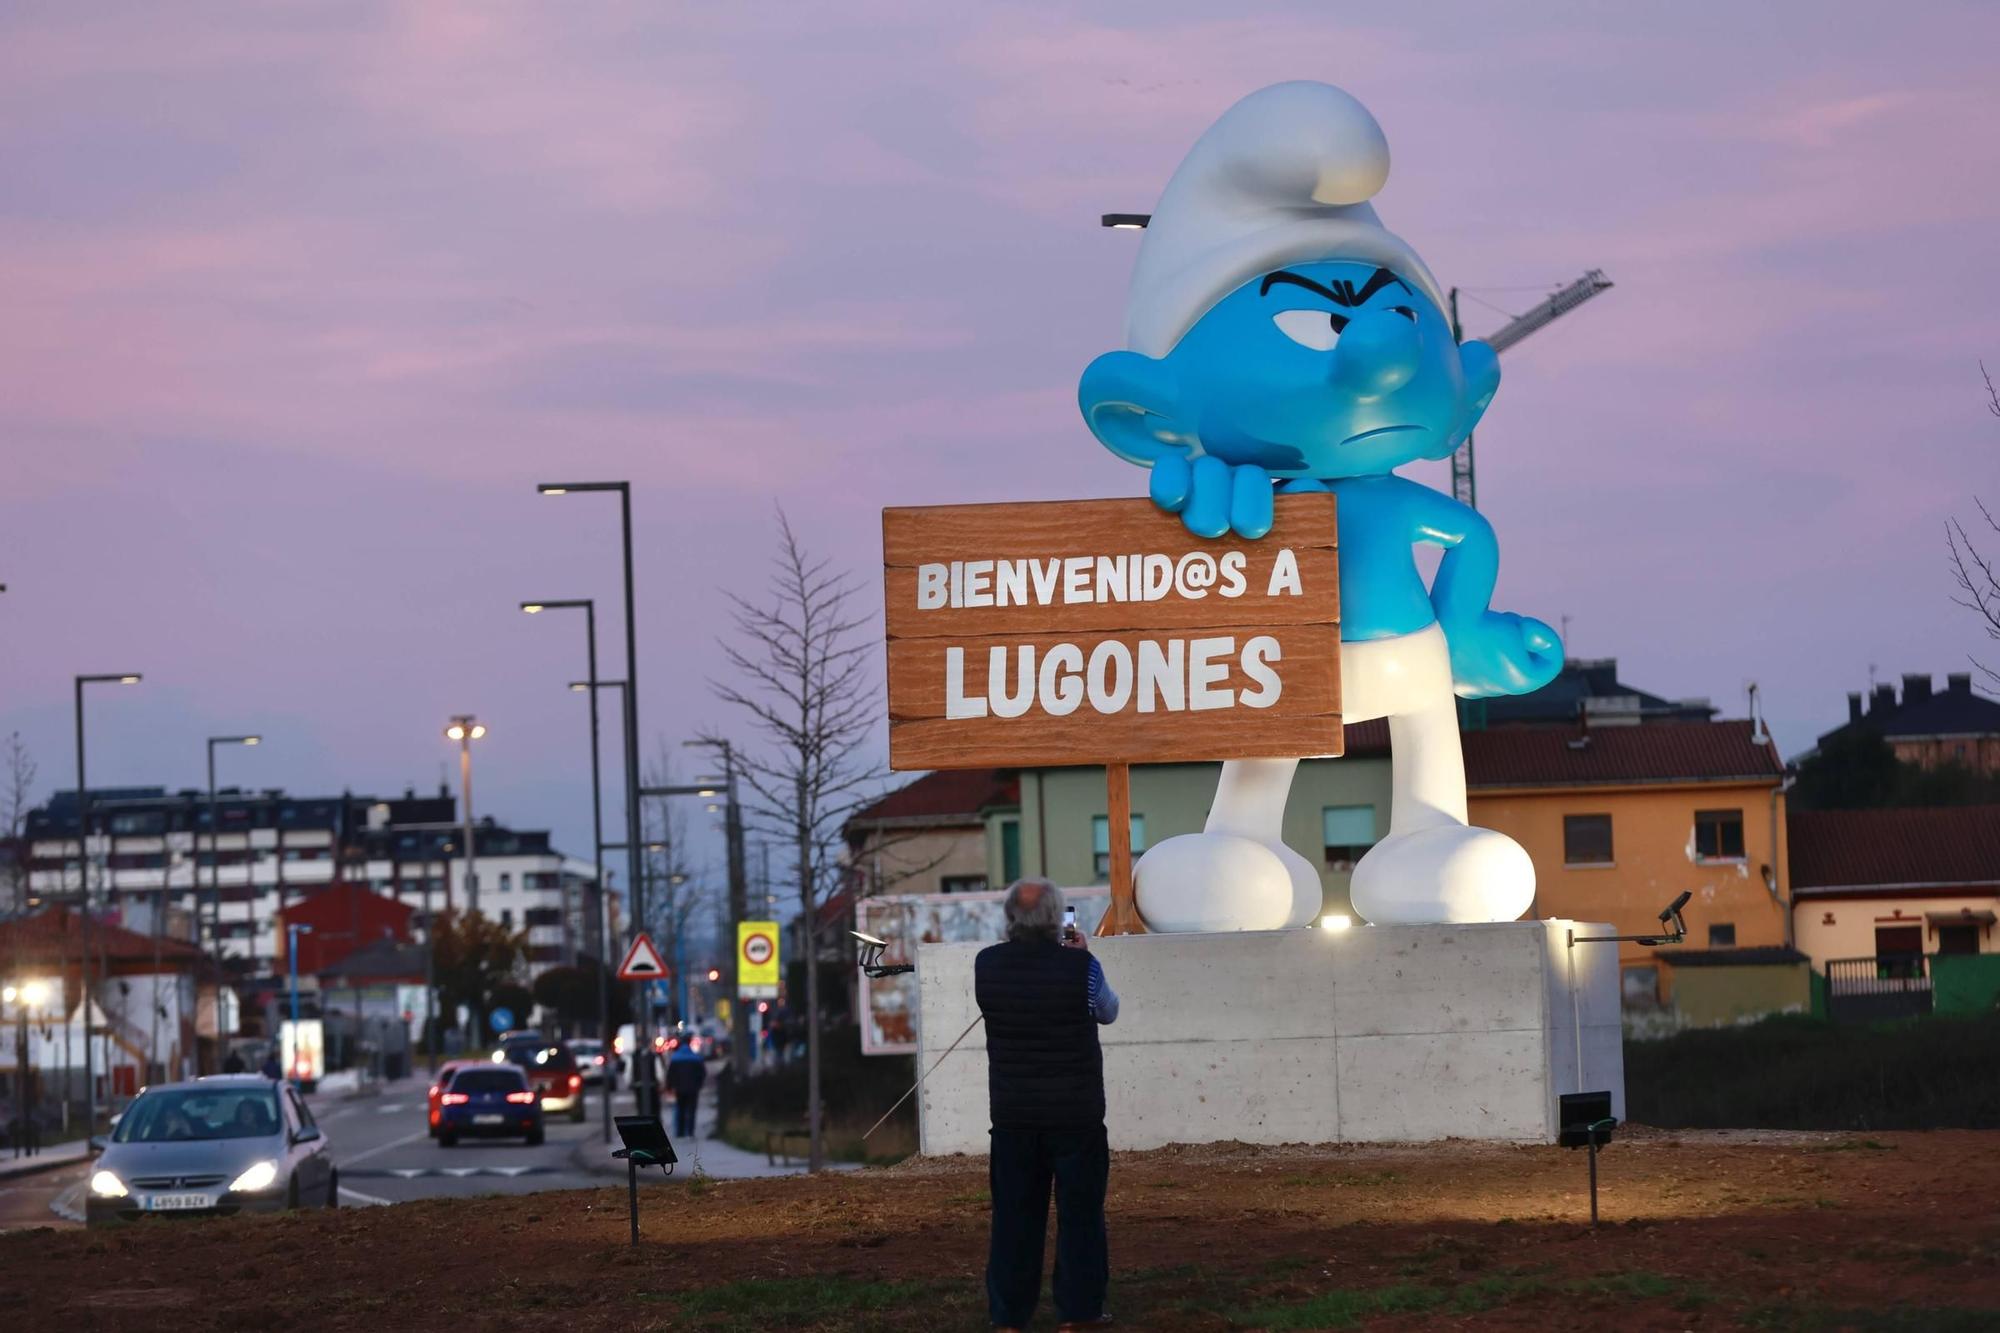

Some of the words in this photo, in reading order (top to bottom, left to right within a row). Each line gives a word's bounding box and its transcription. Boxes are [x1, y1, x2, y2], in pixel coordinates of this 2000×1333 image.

[917, 551, 1247, 610] BIENVENID@S
[1267, 549, 1303, 596] A
[945, 635, 1282, 720] LUGONES
